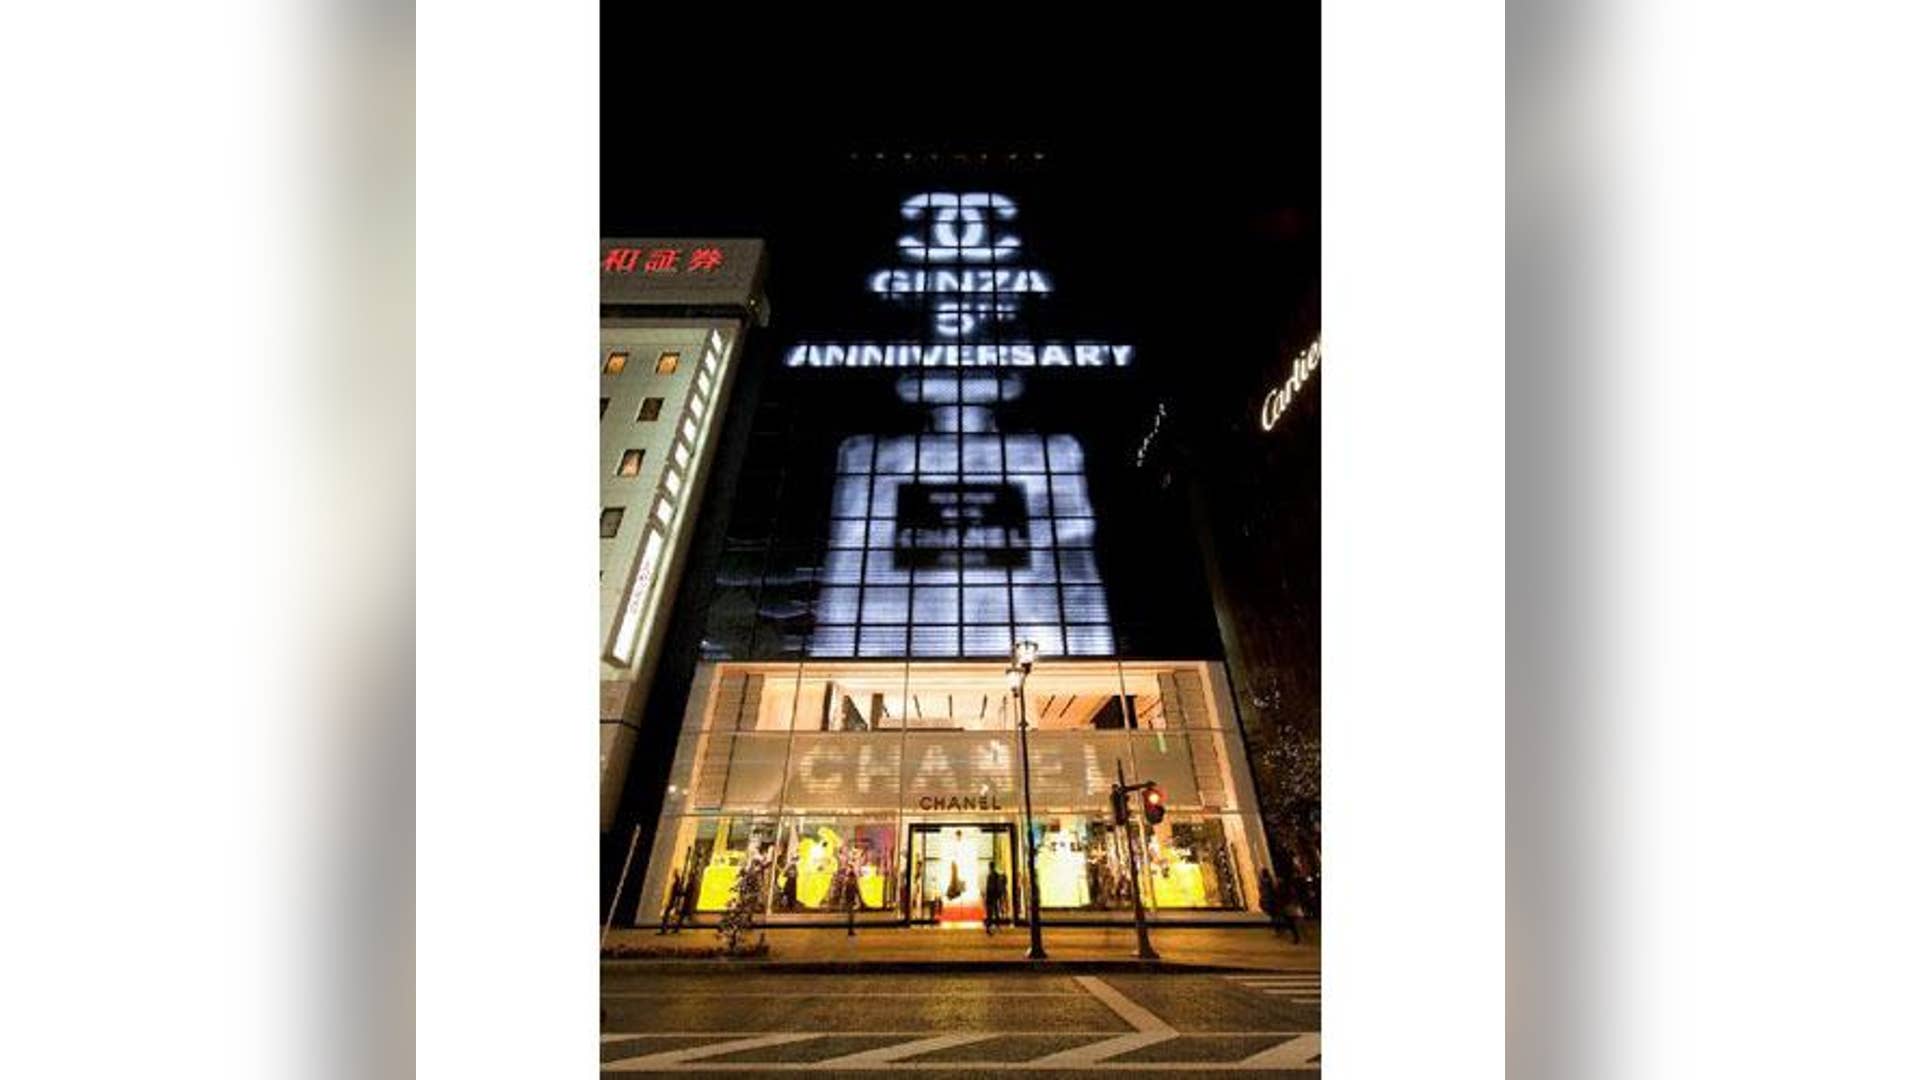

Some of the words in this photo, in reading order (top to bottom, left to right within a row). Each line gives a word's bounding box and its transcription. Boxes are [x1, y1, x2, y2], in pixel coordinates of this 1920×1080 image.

[603, 248, 725, 272] 和証券
[869, 269, 1052, 296] GINZA
[784, 342, 1135, 367] ANNIVERSARY
[800, 743, 1108, 795] CHANEL
[919, 796, 1002, 811] CHANEL
